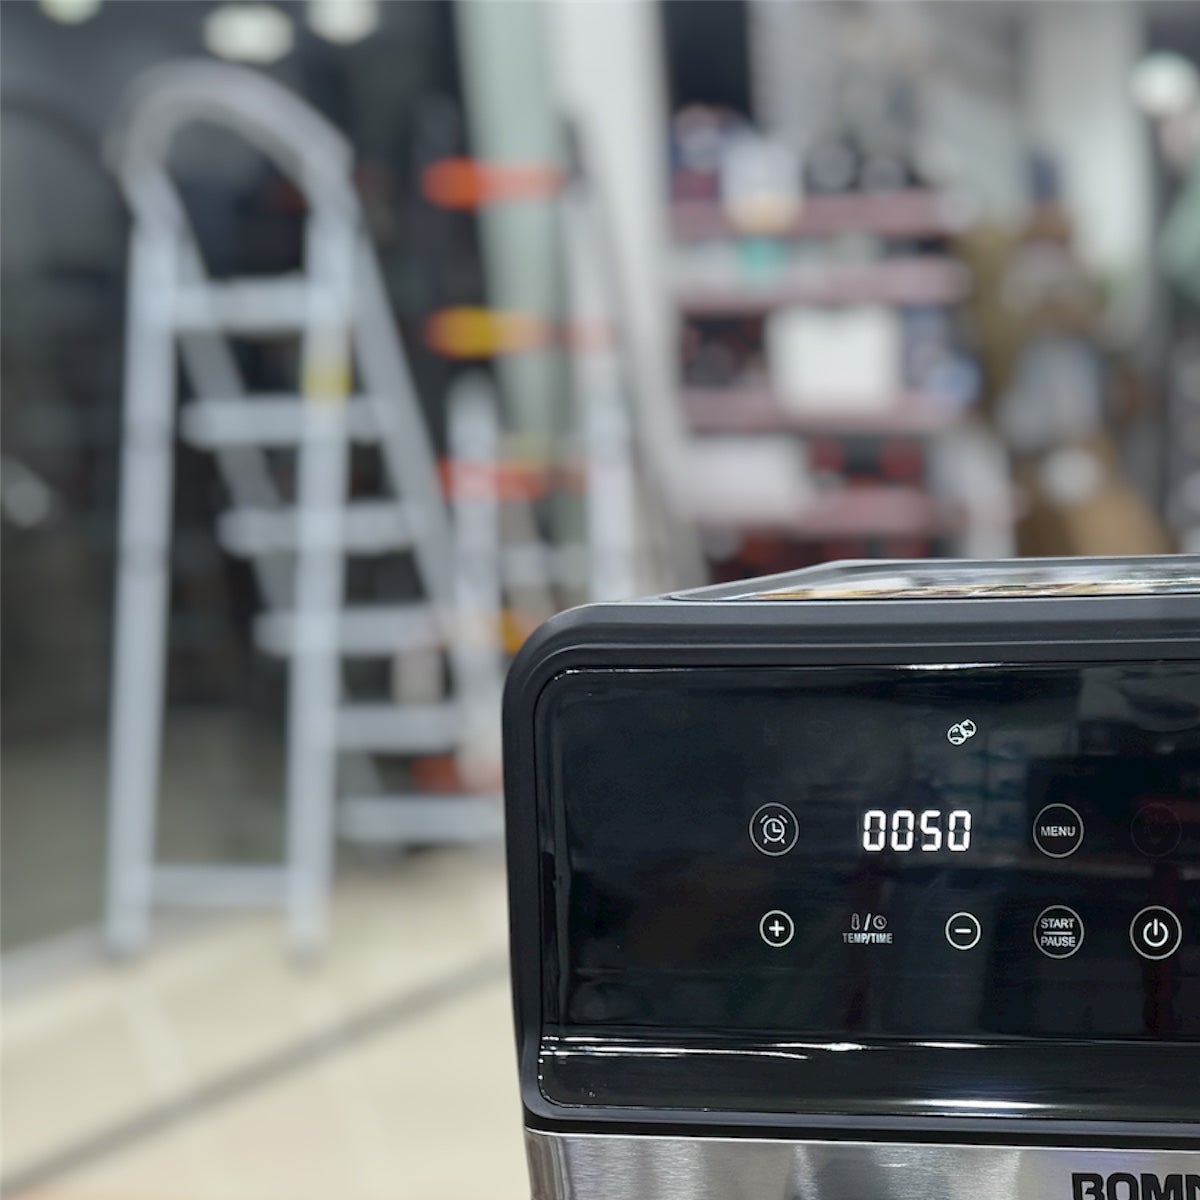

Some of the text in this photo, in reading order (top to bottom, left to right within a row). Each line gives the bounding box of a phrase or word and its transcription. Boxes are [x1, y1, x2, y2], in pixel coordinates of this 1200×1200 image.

[862, 808, 972, 853] 0050
[1040, 825, 1077, 838] MENU
[1040, 918, 1076, 930] START
[841, 932, 894, 945] TEMP/TIME
[1040, 936, 1077, 948] PAUSE
